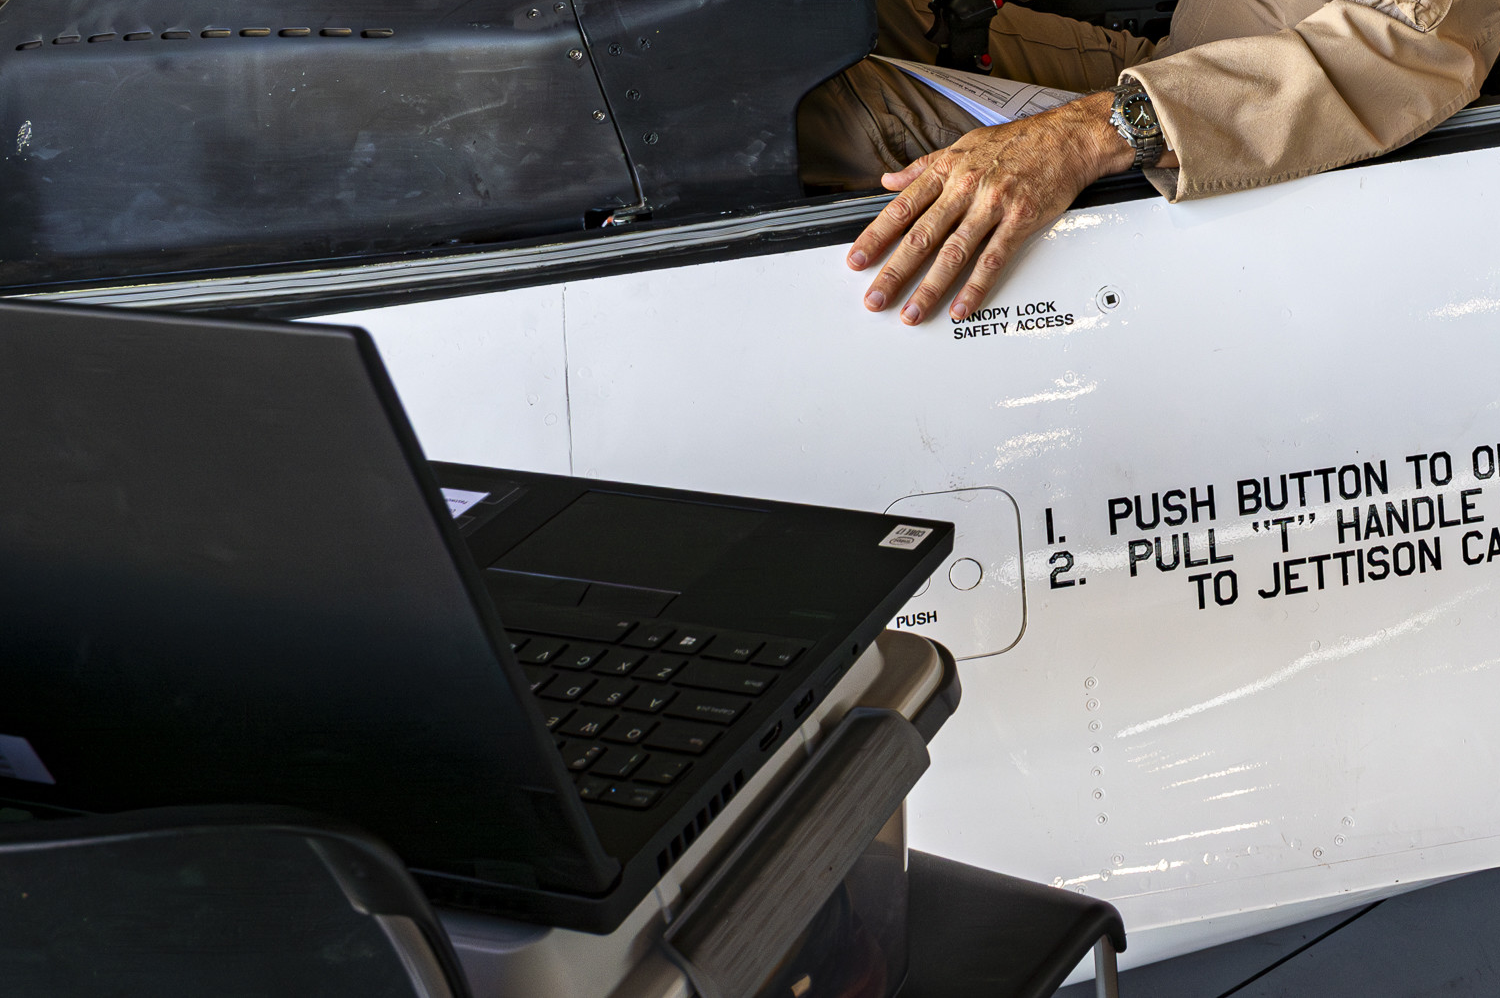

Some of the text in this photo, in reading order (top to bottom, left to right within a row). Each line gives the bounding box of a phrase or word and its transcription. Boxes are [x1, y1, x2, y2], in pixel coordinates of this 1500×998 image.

[953, 313, 1075, 340] SAFETY ACCESS
[1016, 301, 1057, 317] LOCK
[1108, 485, 1216, 535] PUSH
[1237, 460, 1388, 516] BUTTON
[1406, 451, 1452, 489] TO
[1049, 551, 1087, 589] 2.
[1128, 529, 1233, 577] PULL
[1337, 488, 1484, 544] HANDLE
[1188, 570, 1238, 609] TO
[1258, 537, 1442, 599] JETTISON
[896, 610, 938, 629] PUSH
